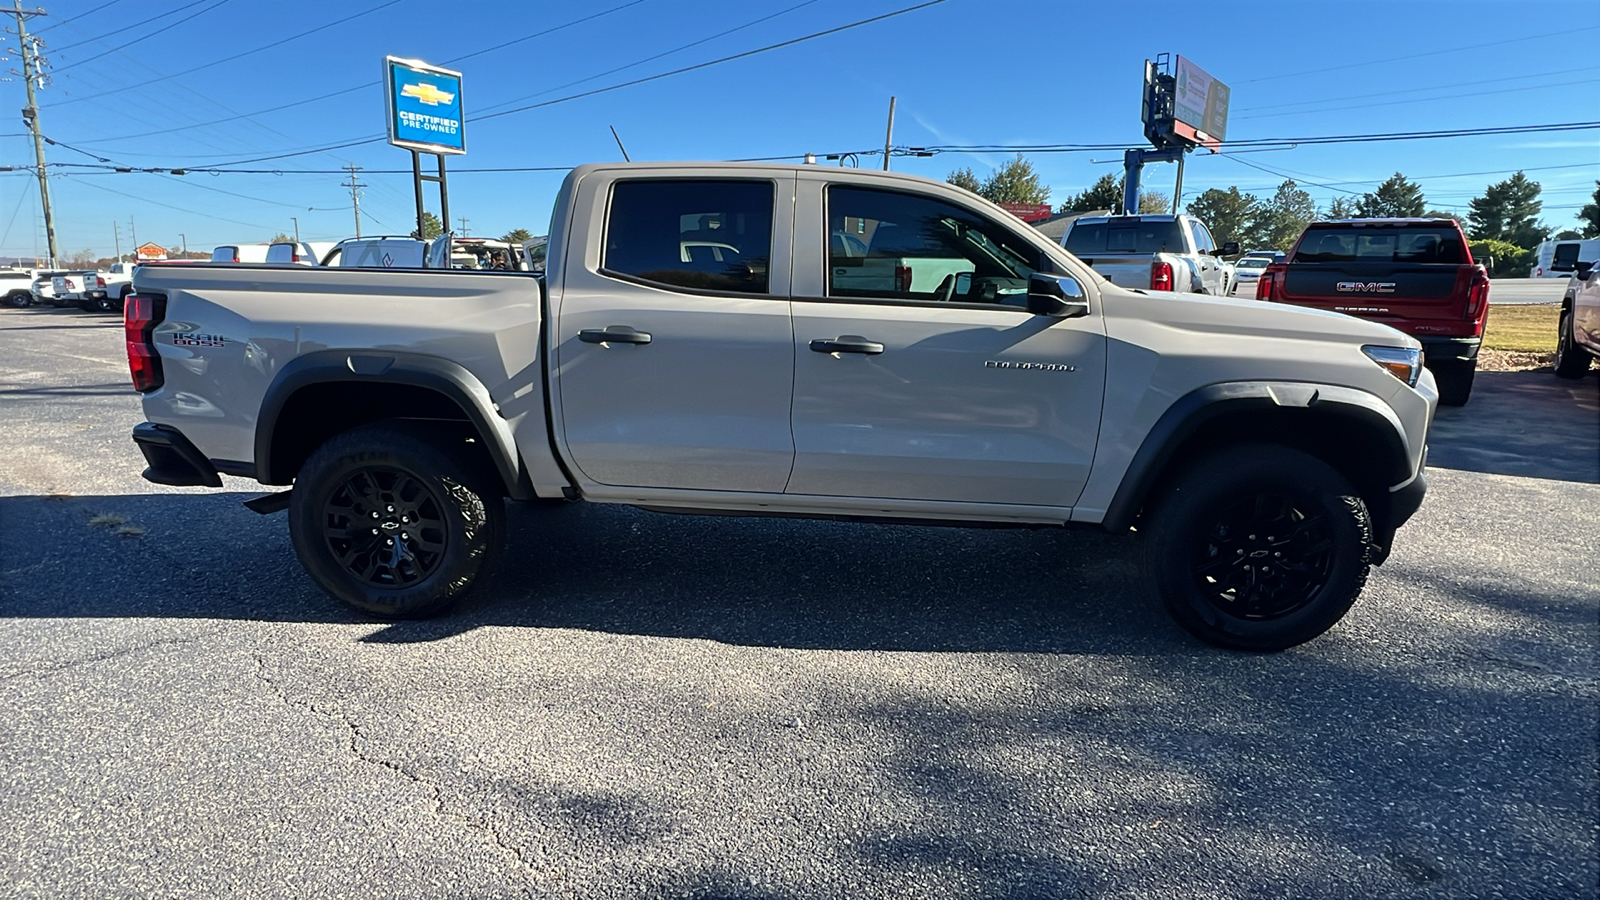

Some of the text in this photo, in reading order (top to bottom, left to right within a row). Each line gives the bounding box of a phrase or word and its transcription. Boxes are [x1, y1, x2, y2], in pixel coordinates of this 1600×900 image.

[399, 110, 459, 128] CERTIFIED
[402, 119, 457, 135] PRE-OWNED
[1336, 281, 1396, 293] GMC
[173, 339, 225, 347] BOSS
